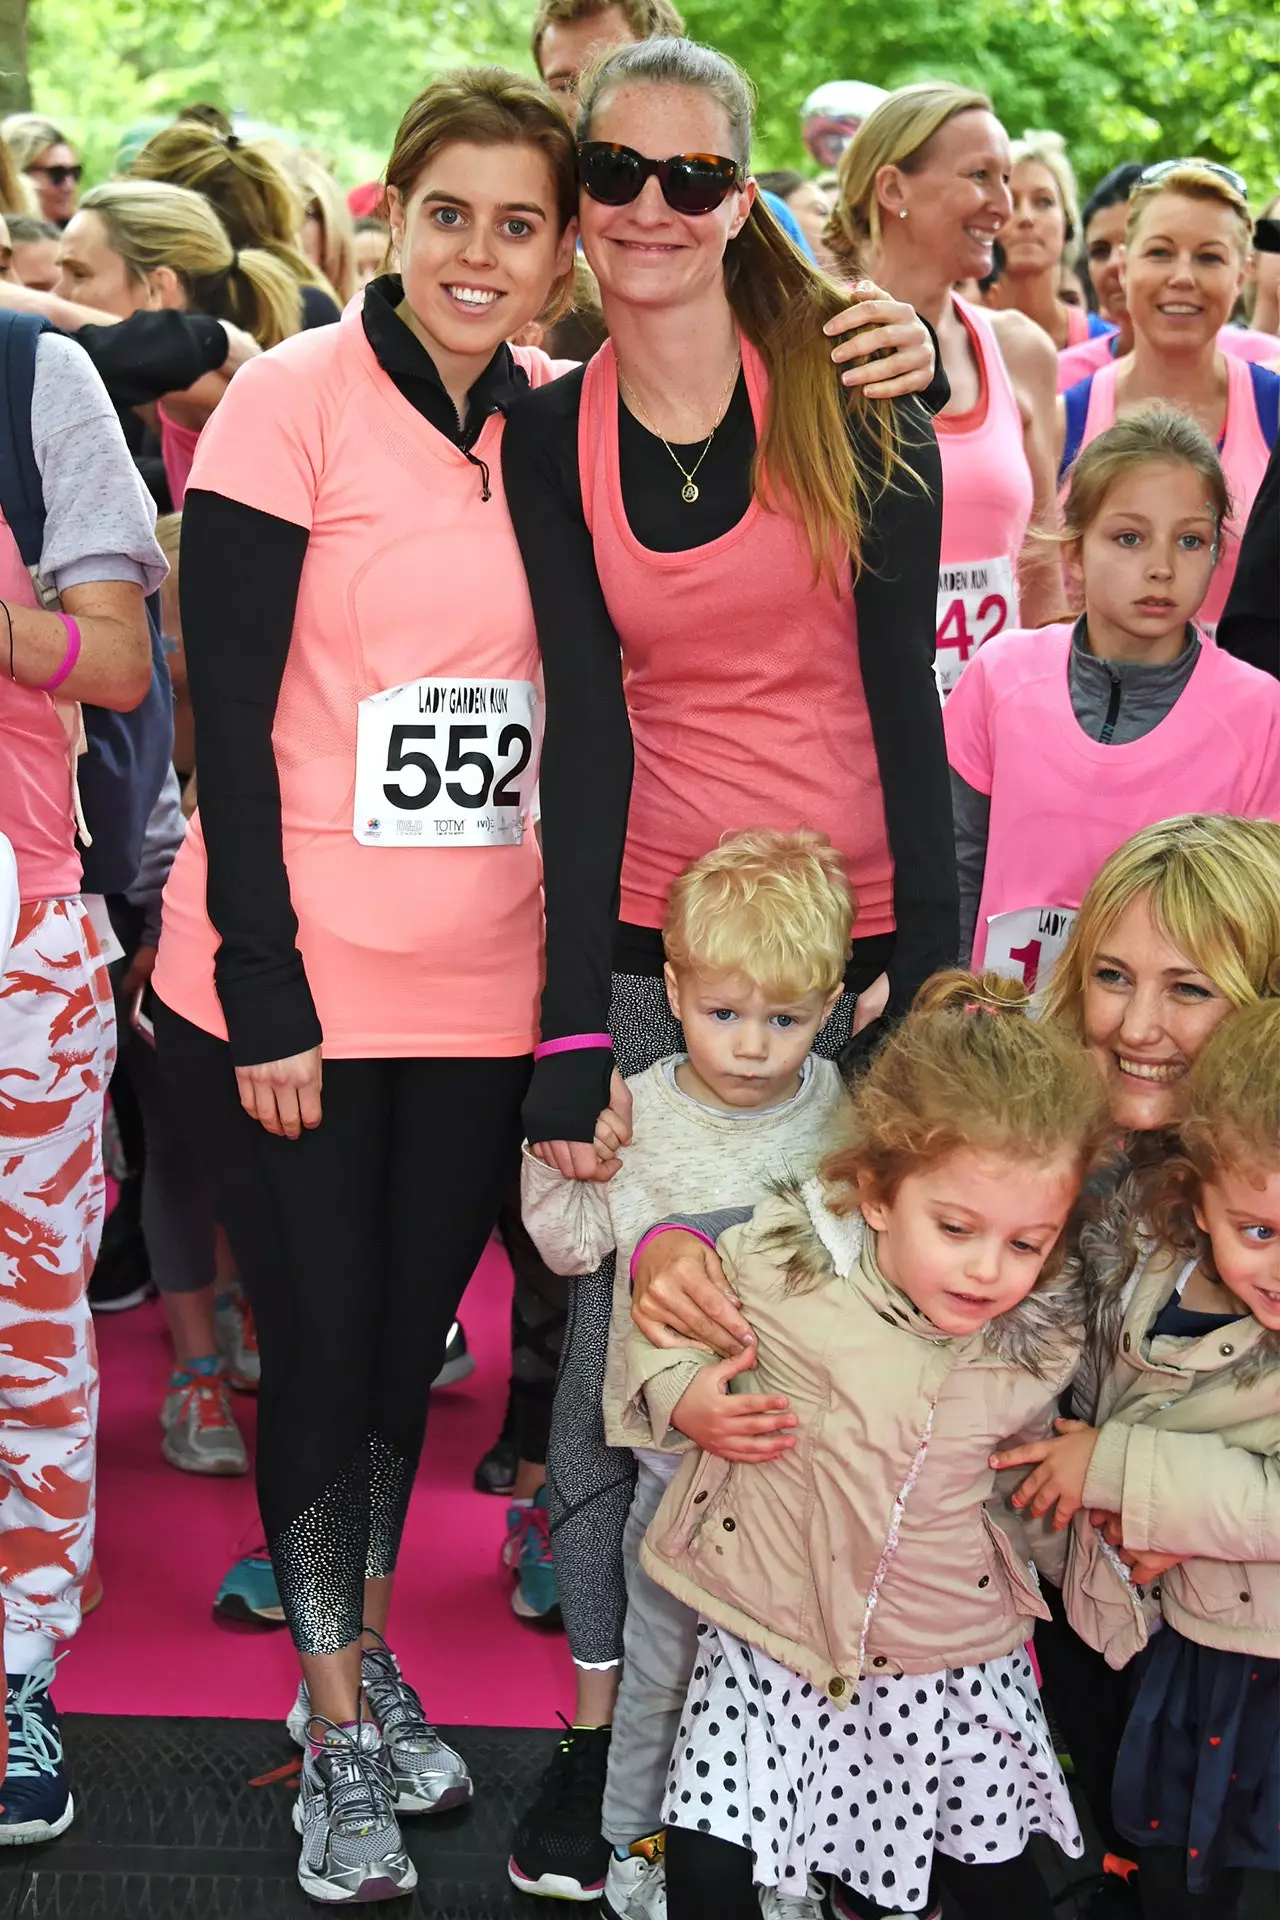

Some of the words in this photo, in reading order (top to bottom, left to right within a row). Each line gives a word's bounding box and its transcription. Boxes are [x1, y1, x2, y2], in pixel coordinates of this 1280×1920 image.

[938, 571, 968, 592] ARDEN
[970, 569, 988, 589] RUN
[936, 594, 1007, 661] 42
[418, 686, 447, 714] LADY
[450, 687, 487, 714] GARDEN
[490, 687, 509, 714] RUN
[383, 723, 532, 810] 552
[433, 819, 465, 832] TOTM
[1038, 909, 1067, 938] LADY
[1009, 939, 1042, 995] 1
